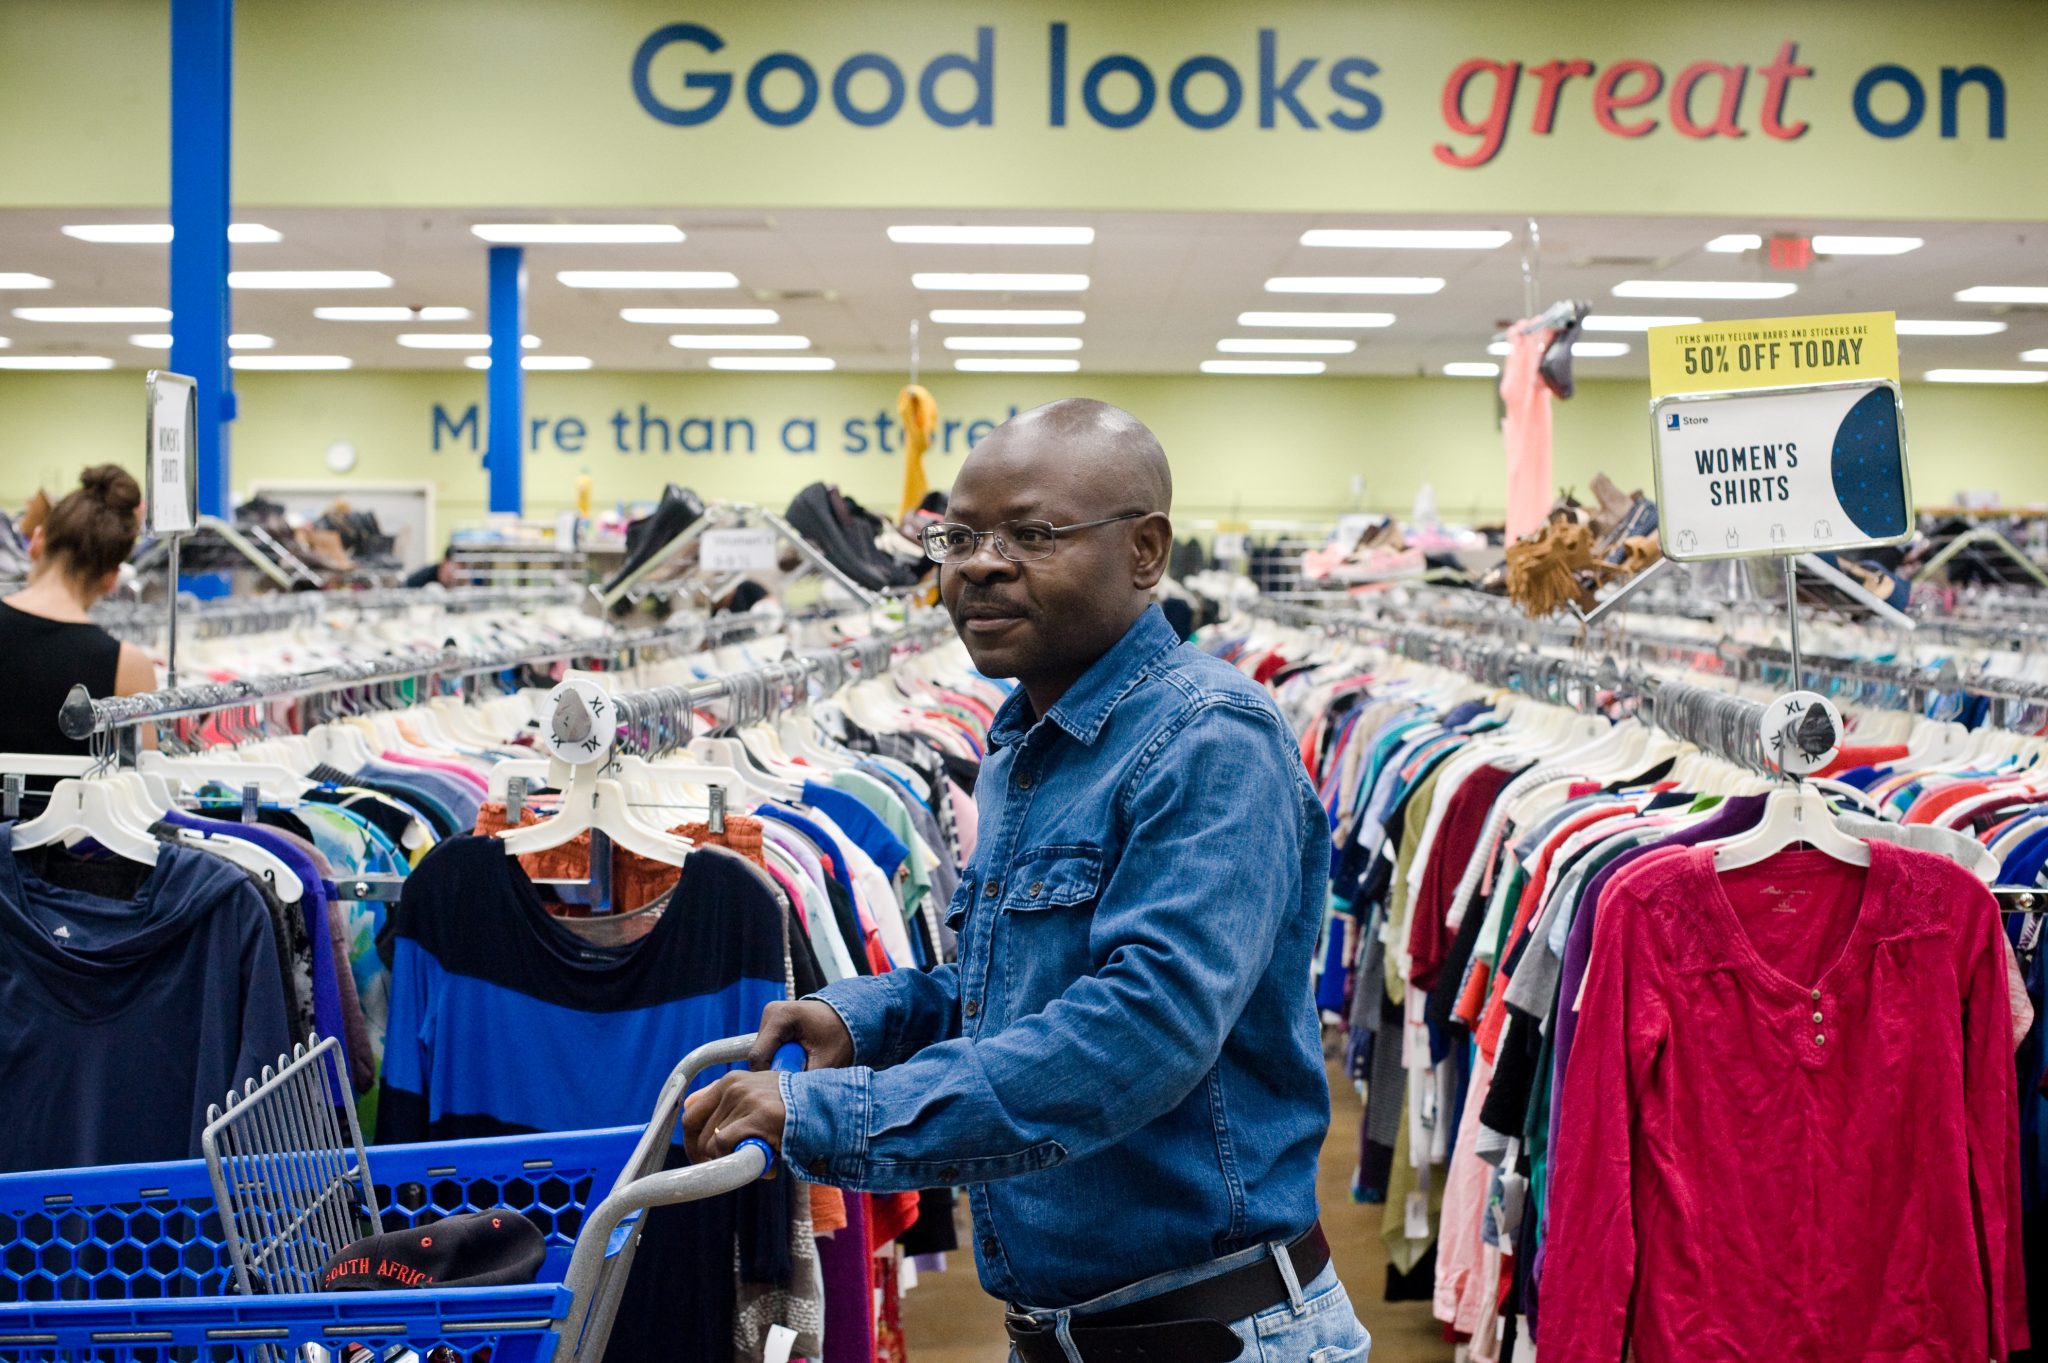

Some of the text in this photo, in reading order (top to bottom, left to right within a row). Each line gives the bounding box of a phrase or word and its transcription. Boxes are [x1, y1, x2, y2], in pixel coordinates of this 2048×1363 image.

[631, 22, 2007, 169] Good looks great on
[1675, 335, 1701, 345] ITEMS
[1704, 334, 1725, 343] WITH
[1728, 331, 1759, 342] YELLOW
[1791, 328, 1807, 338] AND
[1810, 326, 1849, 337] STICKERS
[1853, 325, 1868, 334] ARE
[1684, 337, 1864, 375] 50% OFF TODAY
[432, 404, 587, 453] Mre
[609, 405, 756, 453] than
[780, 417, 818, 454] a
[1683, 416, 1709, 425] Store
[1695, 442, 1798, 475] WOMEN'S
[1710, 475, 1789, 506] SHIRTS
[588, 696, 605, 719] XL
[1784, 700, 1805, 716] XL
[580, 735, 601, 753] XL
[324, 1258, 370, 1288] SOUTH
